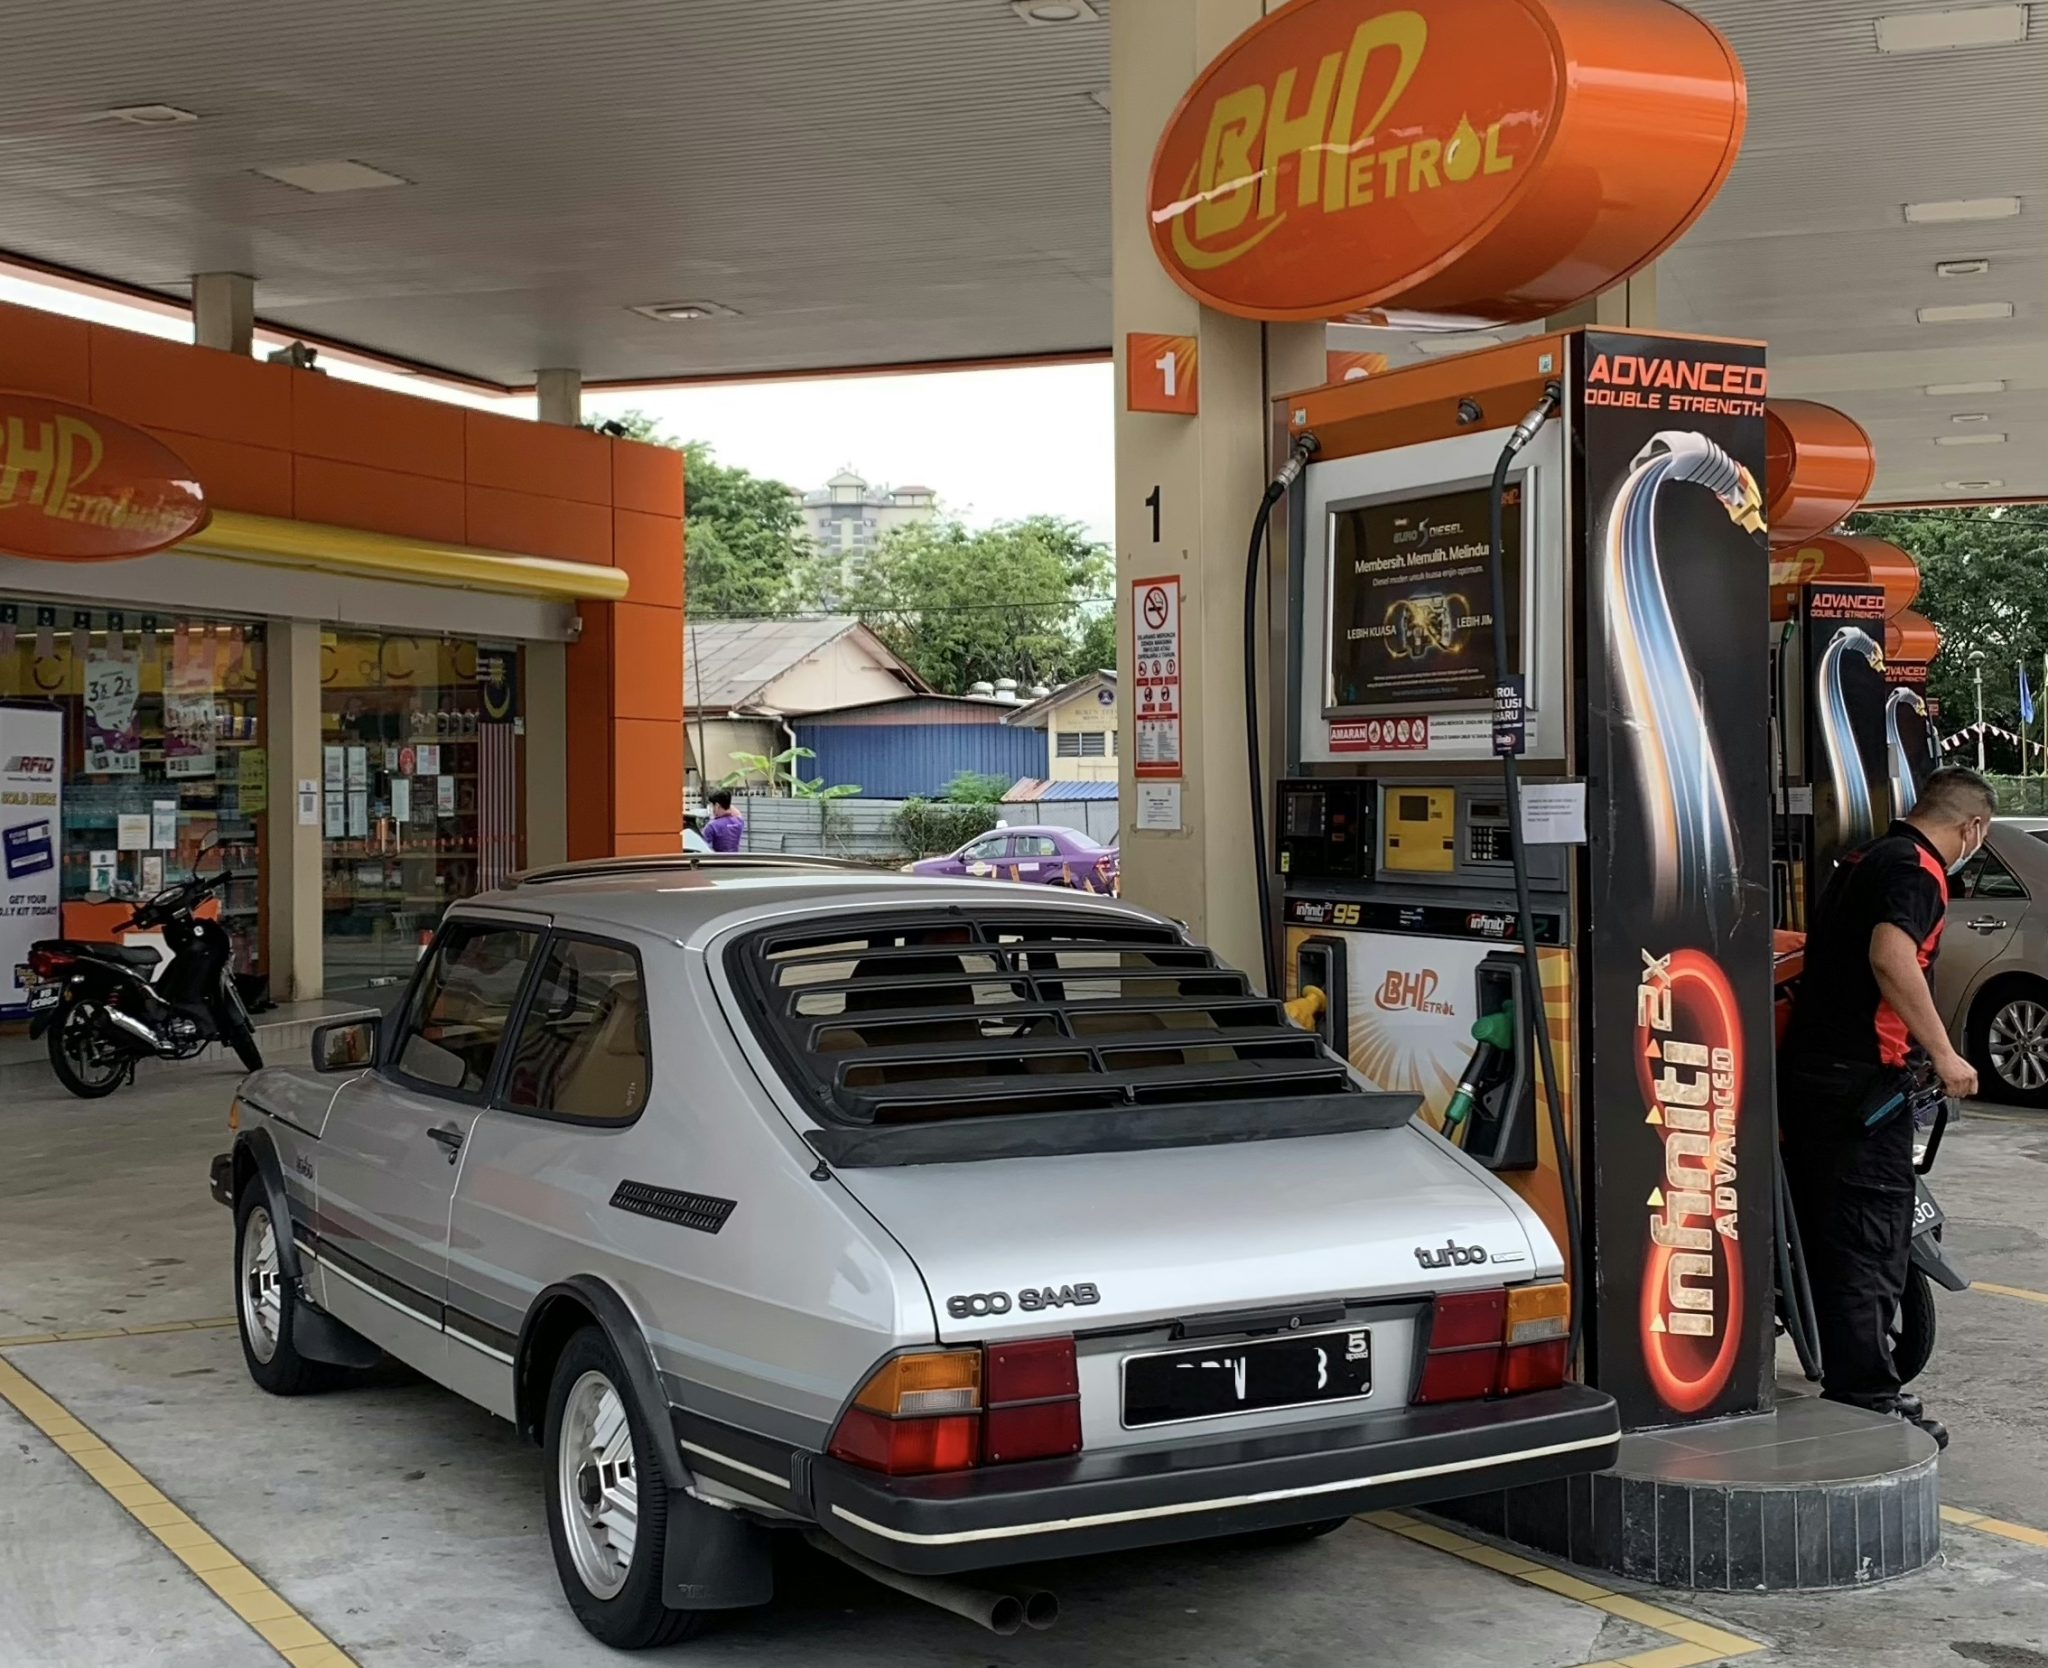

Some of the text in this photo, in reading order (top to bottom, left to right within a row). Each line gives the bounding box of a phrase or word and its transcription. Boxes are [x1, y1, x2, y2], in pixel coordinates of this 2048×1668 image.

[1155, 351, 1176, 397] 1
[1588, 354, 1767, 397] ADVANCED
[1584, 388, 1765, 417] DOUBLE STRENGTH
[1145, 485, 1160, 543] 1
[1429, 522, 1464, 538] DIESEL
[1812, 594, 1885, 609] ADVANCED
[1457, 614, 1479, 629] LEBIH
[1810, 609, 1885, 619] DOUBLE STRENGTH
[1347, 624, 1397, 641] LEBIH KUASA
[1331, 726, 1366, 741] AMARAN
[9, 894, 47, 905] GET YOUR
[1333, 903, 1361, 925] 95
[1710, 1046, 1740, 1241] ADVANCED
[1912, 1201, 1936, 1228] 30
[1414, 1239, 1488, 1269] turbo
[946, 1282, 1101, 1320] 900 SAAB
[1346, 1332, 1367, 1353] 5
